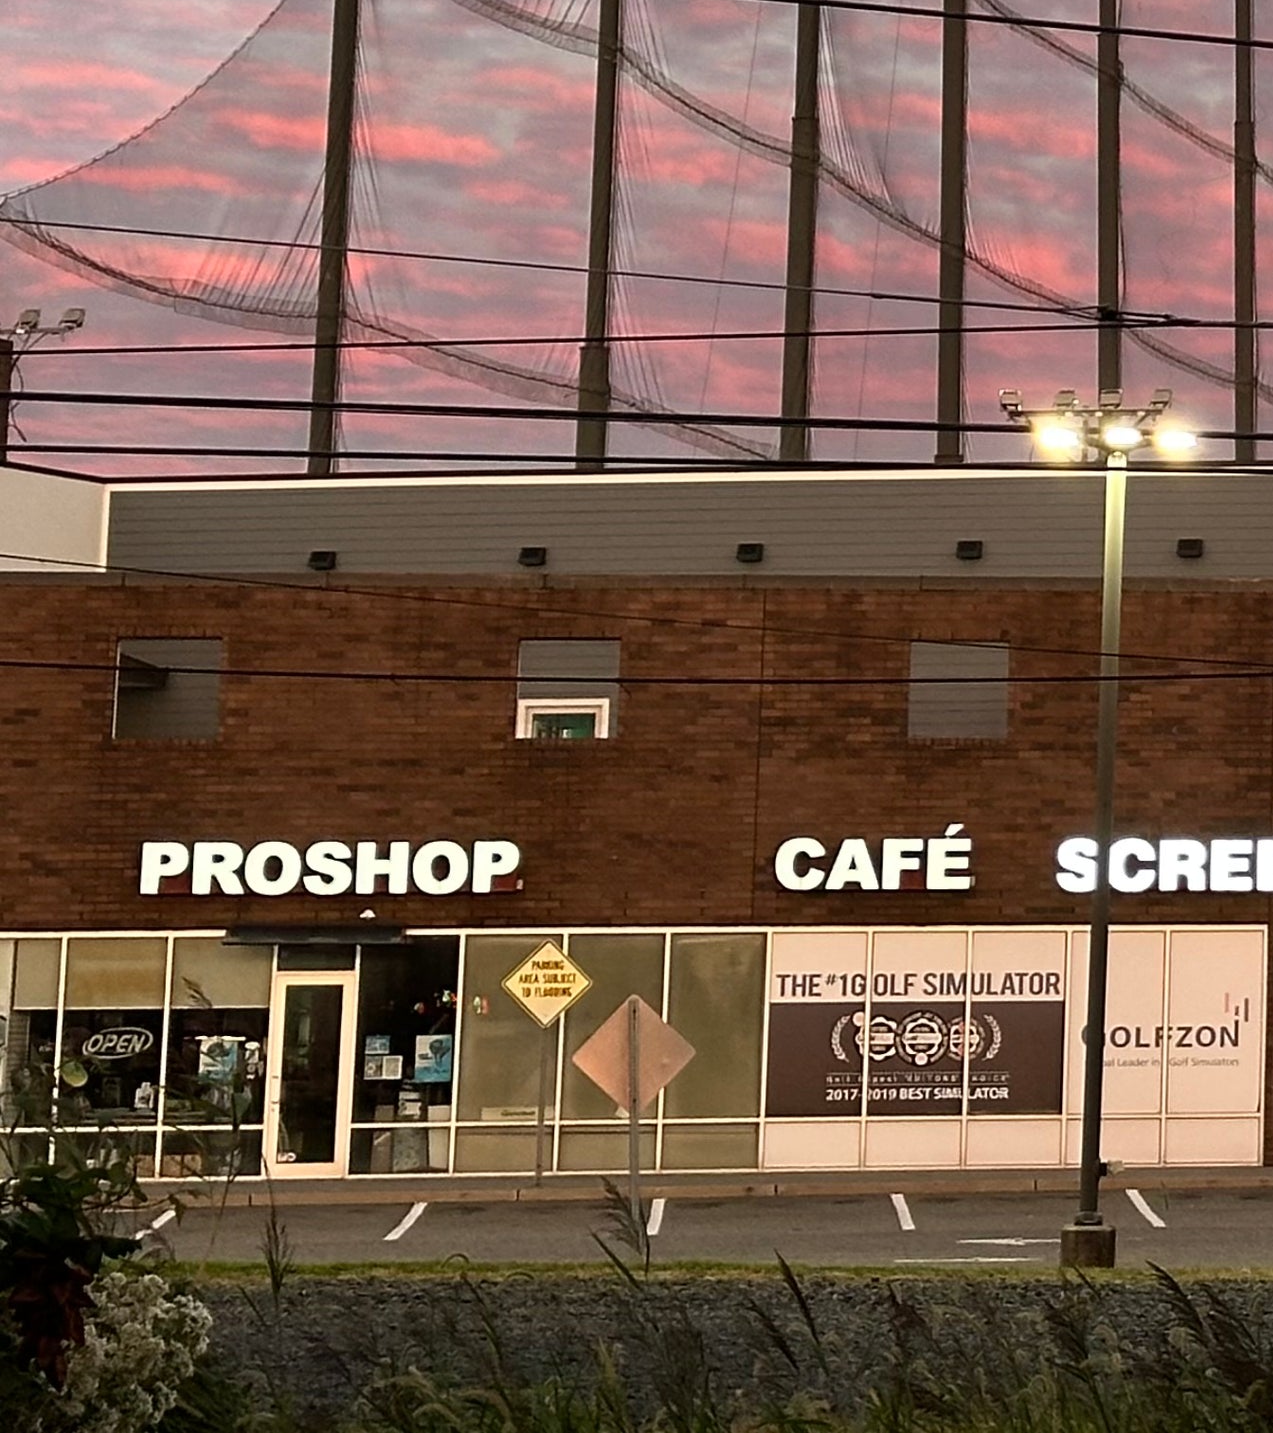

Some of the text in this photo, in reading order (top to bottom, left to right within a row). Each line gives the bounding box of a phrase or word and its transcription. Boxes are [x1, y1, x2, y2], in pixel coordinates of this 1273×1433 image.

[139, 840, 521, 896] PROSHOP
[773, 824, 973, 891] CAFÉ
[519, 973, 576, 984] AREA SUBJECT
[776, 973, 822, 998] THE
[922, 971, 1061, 997] SIMULATOR
[87, 1034, 146, 1053] OPEN
[1081, 1020, 1240, 1048] OLFZON
[1117, 1057, 1149, 1067] Leader
[1169, 1056, 1189, 1067] Golf
[899, 1087, 932, 1101] BEST
